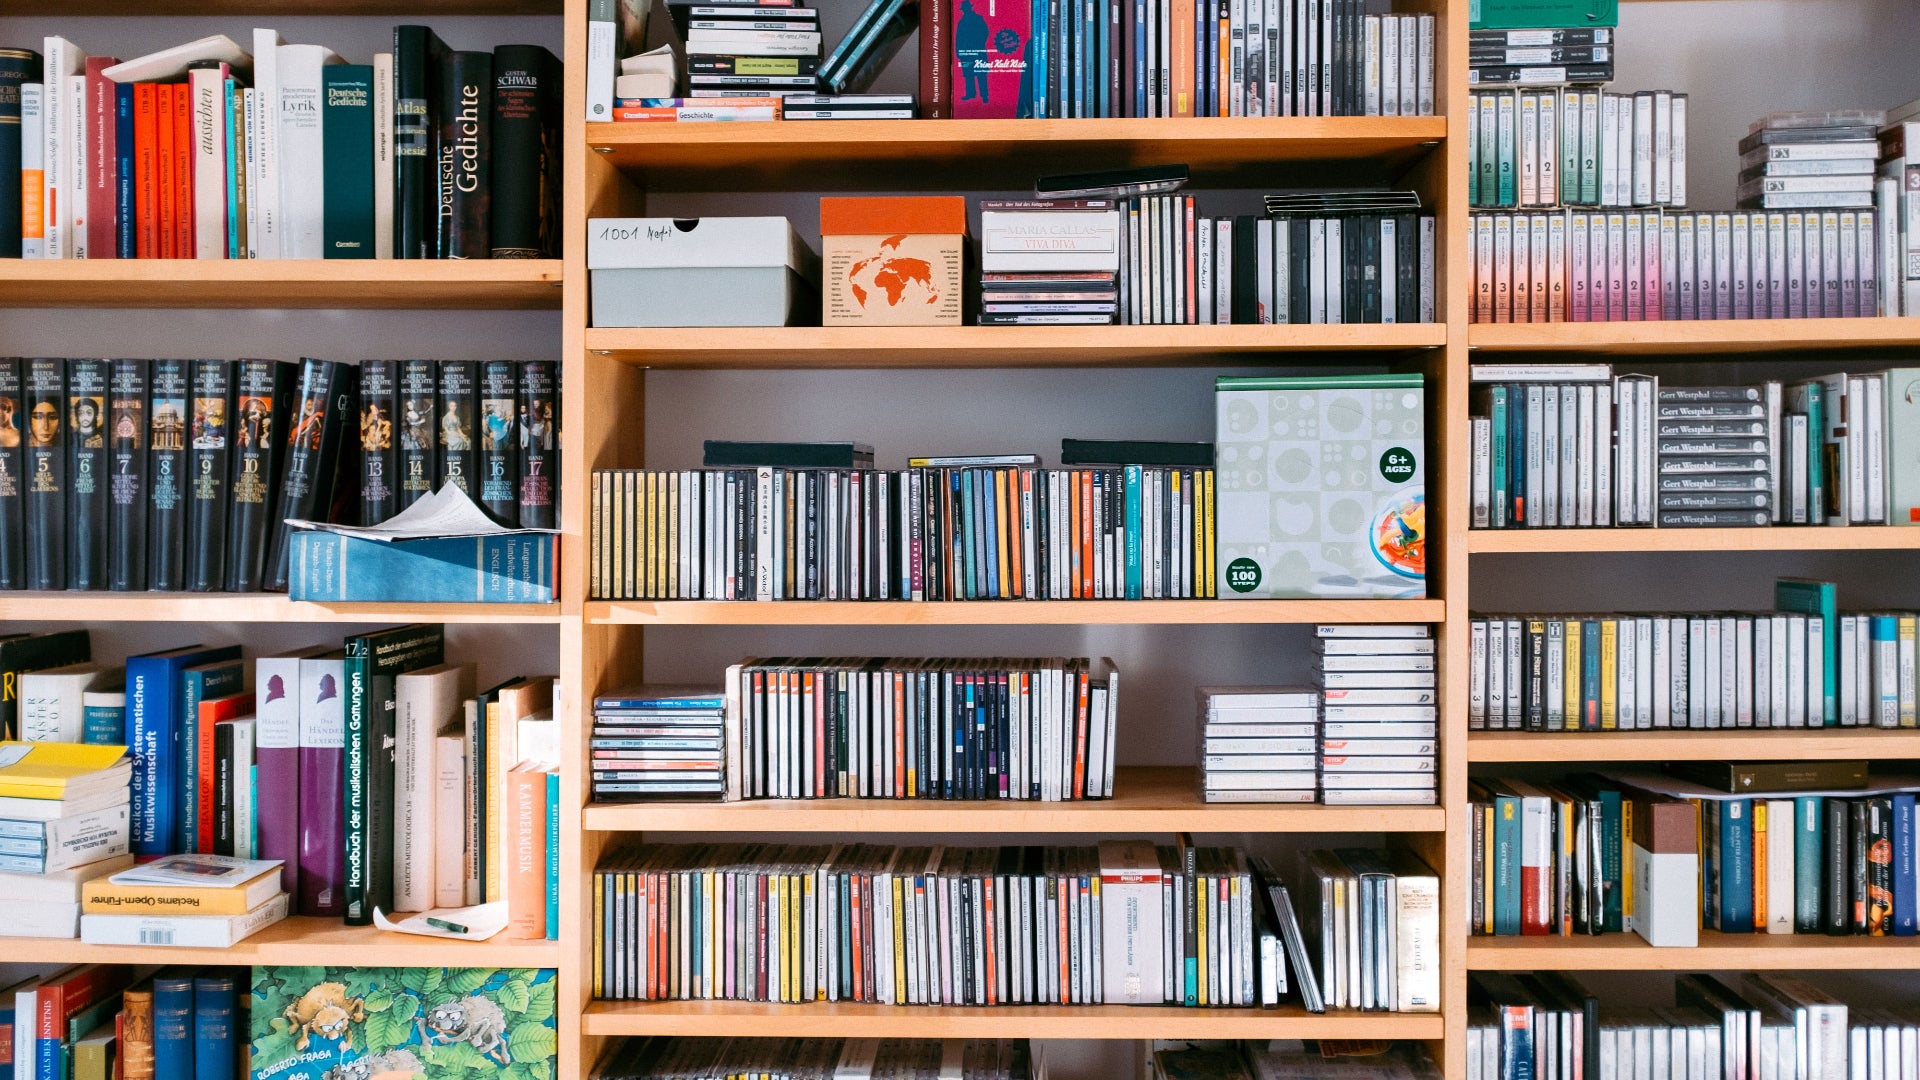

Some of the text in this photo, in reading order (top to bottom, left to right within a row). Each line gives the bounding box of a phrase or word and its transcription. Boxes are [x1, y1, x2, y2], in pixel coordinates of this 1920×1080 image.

[497, 76, 537, 86] SCHWAB
[329, 89, 368, 98] Deutsche
[282, 100, 316, 114] Lyrik
[329, 98, 367, 107] Gedichte
[397, 102, 427, 114] Atlas
[196, 88, 214, 154] aussichten
[455, 85, 478, 193] Gedichte
[1484, 162, 1493, 173] 2
[1502, 162, 1510, 172] 3
[1526, 164, 1532, 172] 1
[1544, 162, 1552, 172] 2
[1569, 159, 1575, 169] 1
[1585, 159, 1593, 169] 2
[439, 146, 455, 217] Deutsche
[600, 227, 638, 241] 1001
[1007, 226, 1097, 235] MARIA CALLAS
[1024, 239, 1076, 248] VIVA DIVA
[1481, 283, 1490, 293] 2
[1499, 283, 1508, 292] 3
[1518, 283, 1526, 293] 4
[1536, 282, 1544, 292] 5
[1554, 282, 1561, 292] 6
[1577, 281, 1585, 291] 5
[1595, 281, 1603, 290] 4
[1613, 281, 1621, 290] 3
[1630, 281, 1638, 291] 2
[1650, 281, 1656, 290] 1
[1667, 282, 1673, 291] 1
[1683, 282, 1691, 291] 2
[1702, 281, 1709, 290] 3
[1719, 281, 1727, 291] 4
[1737, 280, 1746, 290] 5
[1756, 280, 1764, 290] 6
[1772, 280, 1780, 290] 7
[1791, 279, 1799, 289] 8
[1809, 280, 1817, 289] 9
[1827, 280, 1839, 290] 10
[1844, 279, 1856, 289] 11
[1862, 280, 1875, 289] 12
[1658, 391, 1710, 400] Gert Westphal
[1679, 407, 1714, 417] Westphal
[1680, 425, 1714, 434] Westphal
[1680, 443, 1716, 453] Westphal
[38, 458, 48, 472] 5
[80, 458, 91, 473] 6
[243, 458, 258, 473] 10
[1388, 454, 1408, 469] 6+
[1681, 461, 1716, 471] Westphal
[119, 460, 129, 474] 7
[160, 460, 171, 475] 8
[201, 460, 212, 475] 9
[368, 462, 383, 477] 13
[408, 461, 423, 476] 14
[446, 461, 462, 476] 15
[490, 461, 505, 476] 16
[529, 461, 543, 475] 17
[1385, 465, 1412, 473] AGES
[1663, 479, 1716, 489] Gert Westphal
[1663, 497, 1717, 507] Gert Westphal
[1681, 515, 1717, 525] Westphal
[491, 548, 499, 591] ENGLISCH
[1231, 570, 1257, 581] 100
[132, 675, 144, 842] Lexikon der Systematischen
[185, 680, 195, 828] Handbuch der musikalischen Figurenlehre
[349, 672, 364, 888] Handbuch der musikalischen Gattungen
[143, 731, 157, 842] Musikwissenschaft
[519, 783, 534, 874] KAMMERMUSIK
[404, 807, 413, 898] ANALECTA MUSICOLOGICA
[90, 895, 201, 907] Reclams Opern-Führer
[43, 1000, 51, 1057] BEKENNTNIS
[256, 1049, 332, 1080] ROBERTO FRAGA
